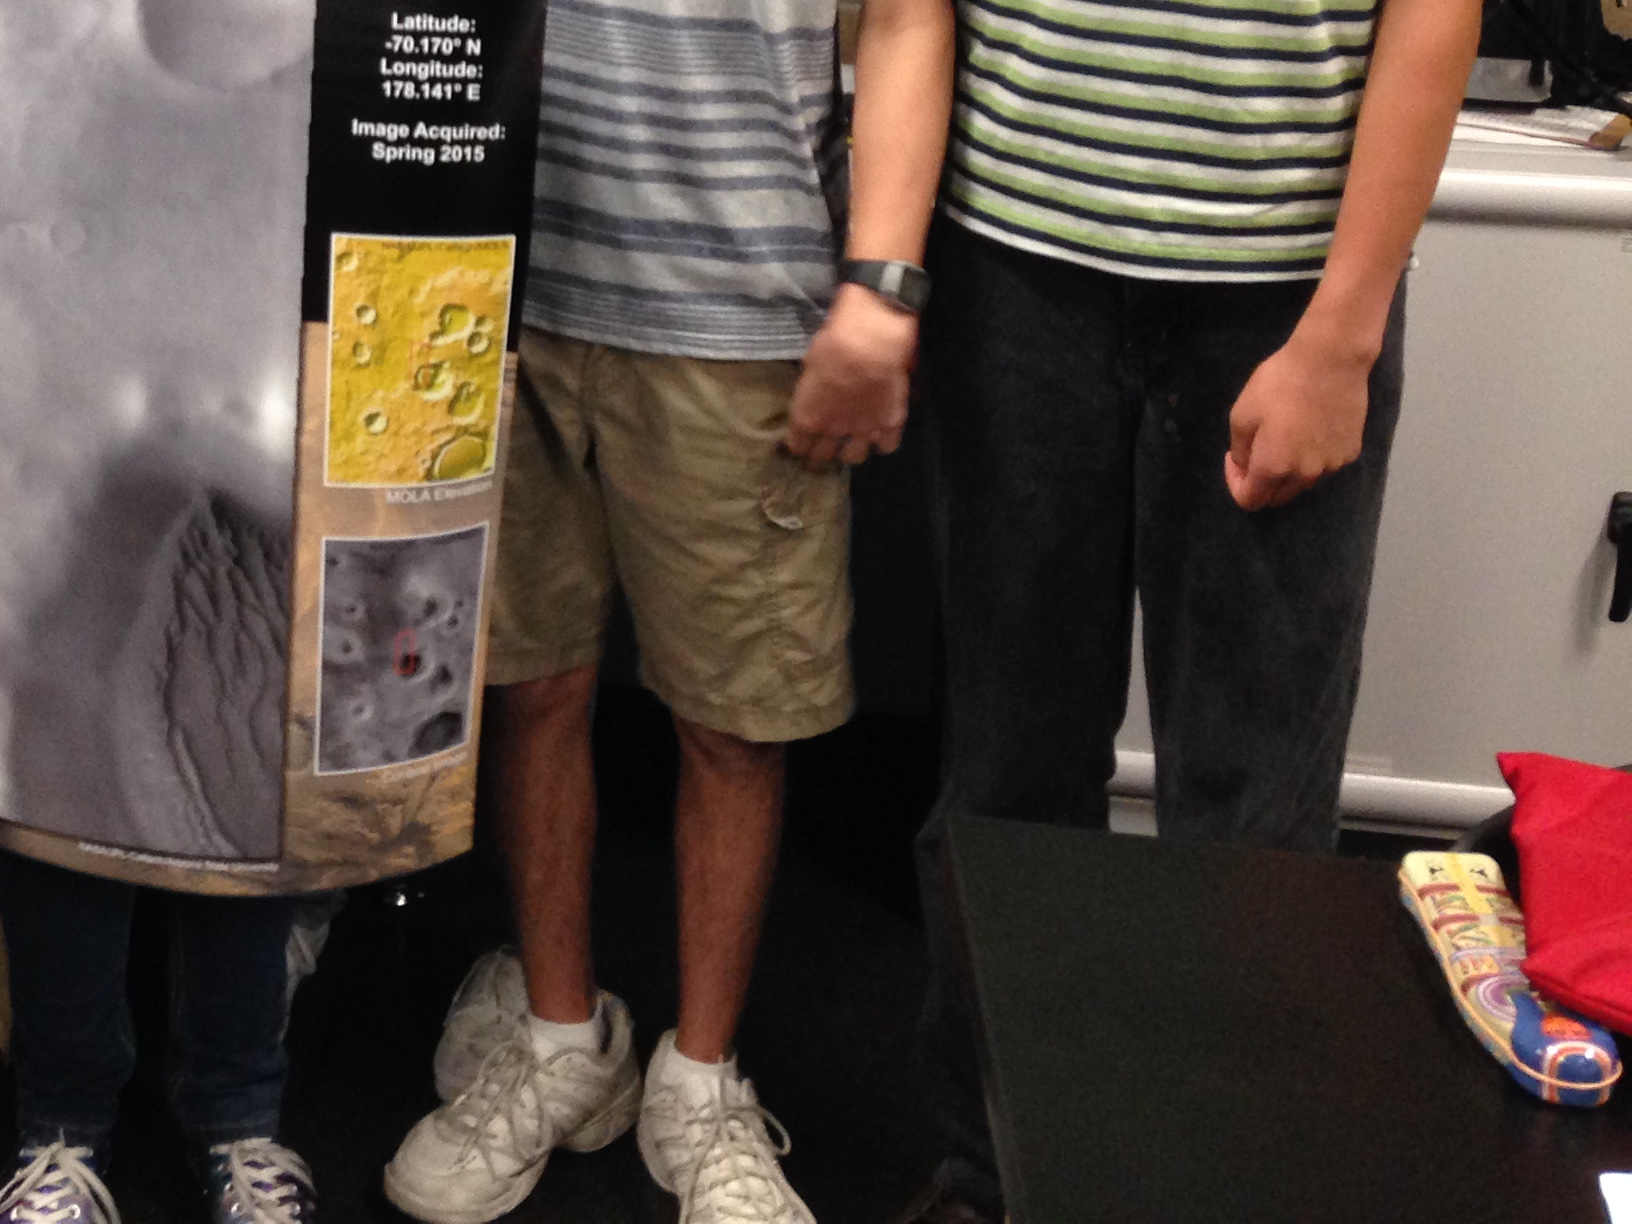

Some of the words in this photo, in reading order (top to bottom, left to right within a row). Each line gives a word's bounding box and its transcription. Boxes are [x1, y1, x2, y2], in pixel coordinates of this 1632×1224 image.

[391, 11, 477, 34] Latitude:
[465, 38, 482, 56] N
[379, 56, 484, 81] Longitude:
[381, 80, 463, 101] 178.141°
[466, 83, 482, 101] E
[351, 118, 410, 142] Image
[414, 121, 507, 144] Acquired:
[371, 141, 435, 166] Spring
[439, 144, 486, 163] 2015
[385, 486, 432, 504] MOLA
